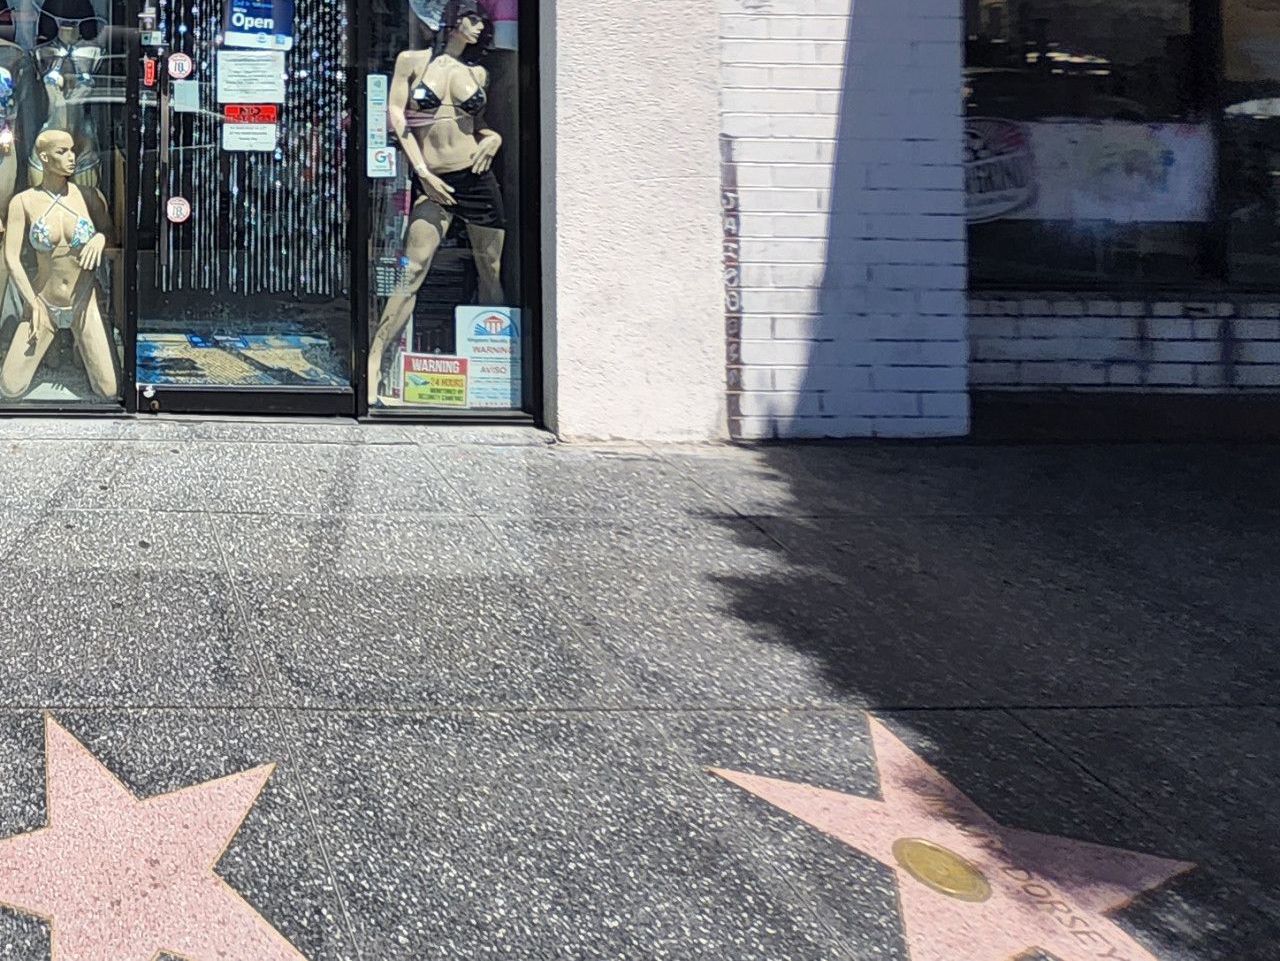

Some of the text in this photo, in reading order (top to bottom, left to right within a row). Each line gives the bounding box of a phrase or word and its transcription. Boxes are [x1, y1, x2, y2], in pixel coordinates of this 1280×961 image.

[231, 12, 274, 30] Open
[472, 345, 513, 355] WARNING
[411, 358, 460, 373] WARNING
[480, 366, 507, 374] AVISO
[441, 378, 464, 387] HOURS
[1002, 867, 1130, 961] DORSEY
